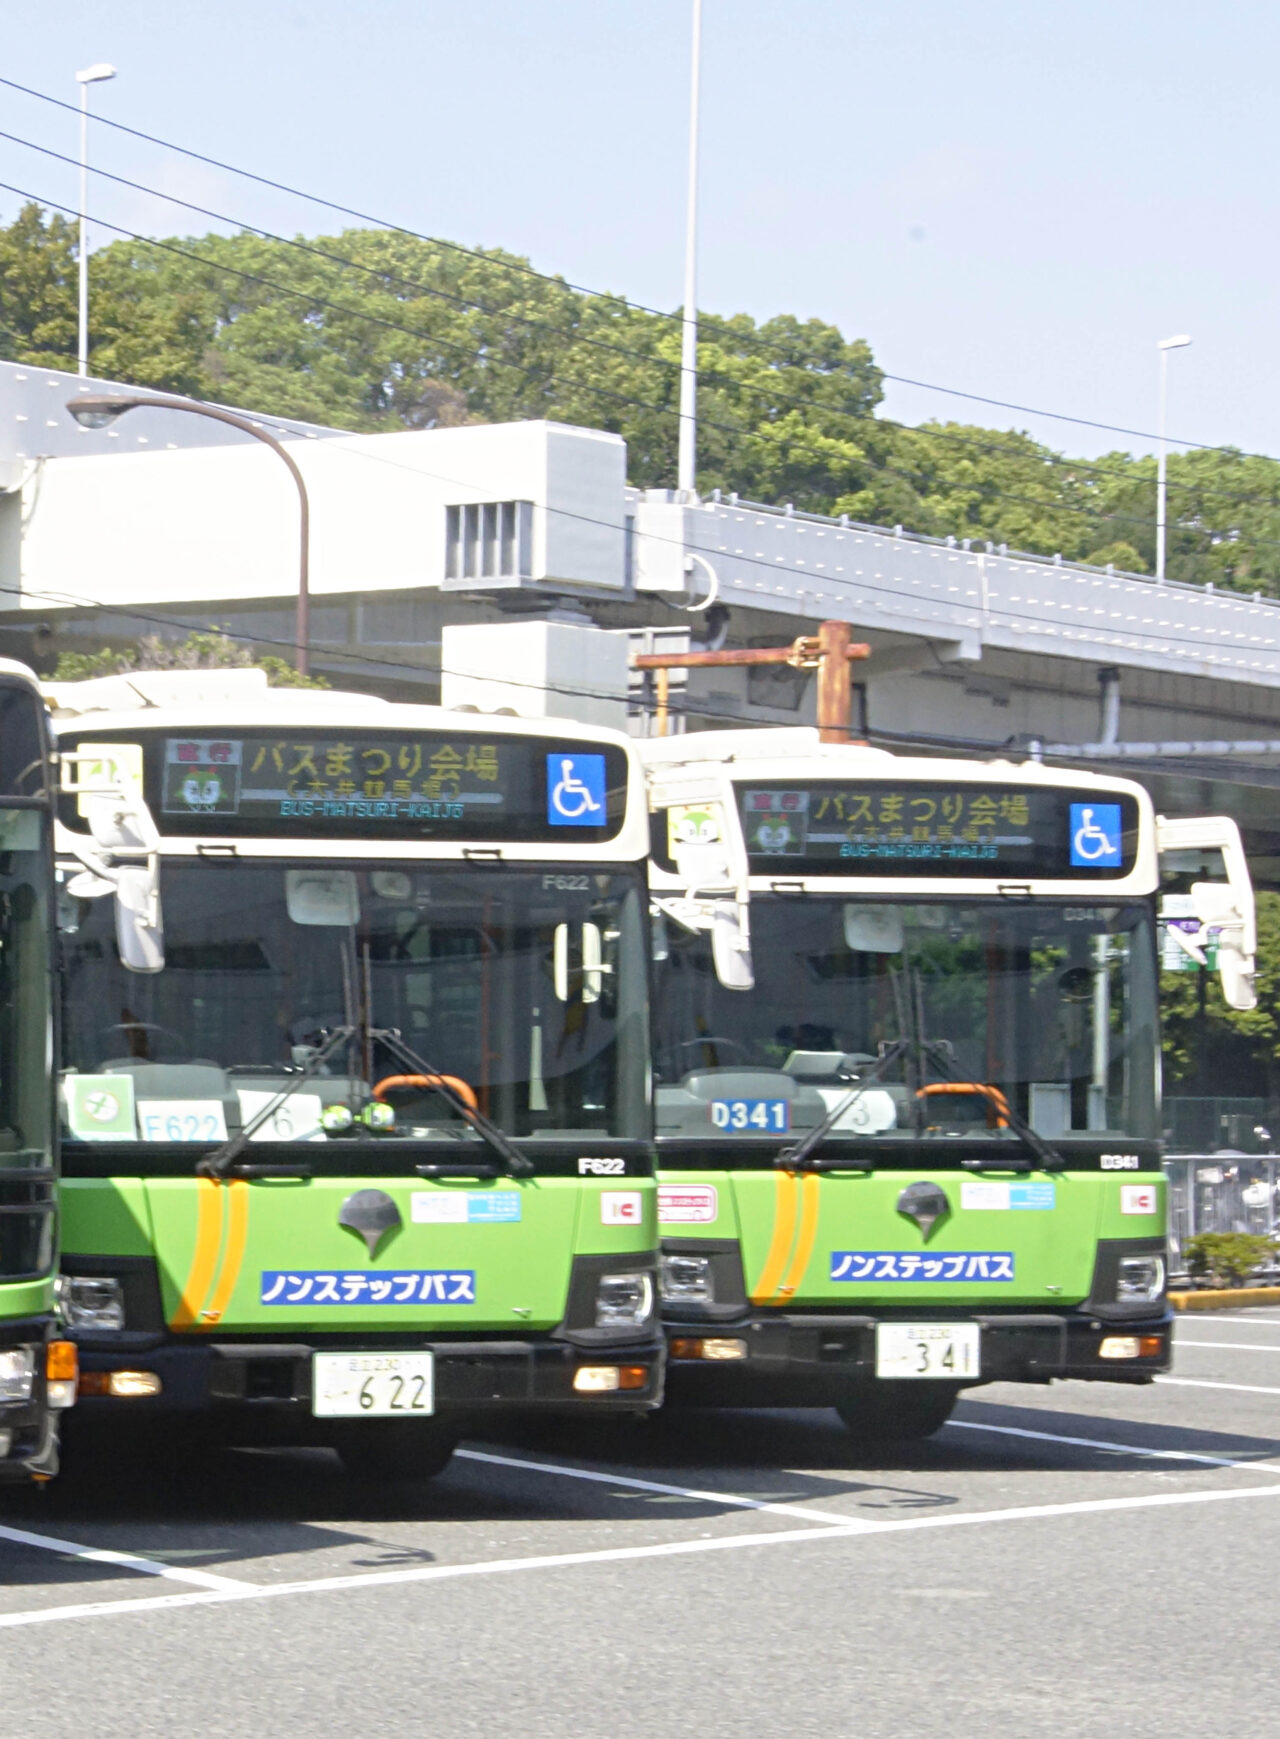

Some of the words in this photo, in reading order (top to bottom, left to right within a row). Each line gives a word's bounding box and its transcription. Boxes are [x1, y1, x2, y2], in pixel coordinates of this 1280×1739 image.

[250, 741, 499, 782] バスまつり会場
[814, 792, 1030, 826] バスまつり会場
[542, 874, 590, 891] F622
[271, 1104, 295, 1138] 6
[711, 1101, 786, 1129] D341
[852, 1098, 871, 1127] 3
[144, 1114, 220, 1141] F622
[578, 1157, 626, 1174] F622
[1099, 1154, 1139, 1170] D341
[830, 1254, 1014, 1279] ノンステップバス
[261, 1272, 475, 1304] ノンステップバス
